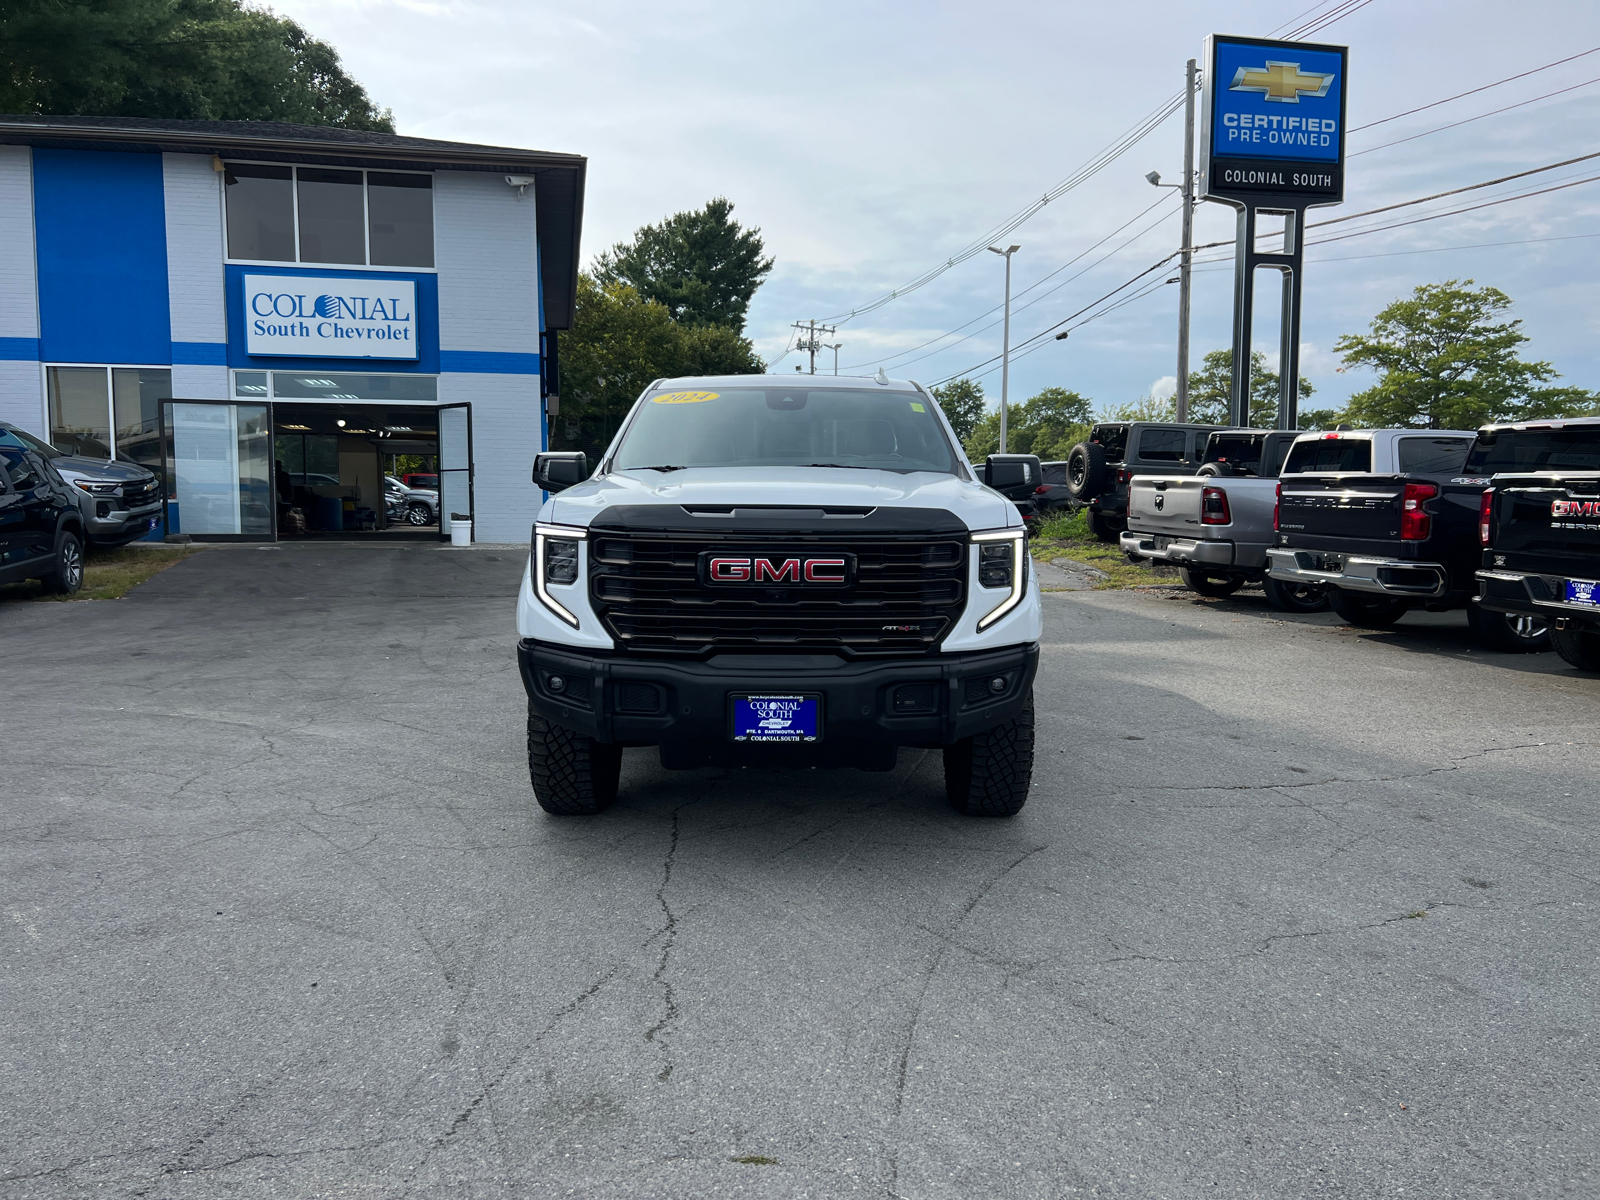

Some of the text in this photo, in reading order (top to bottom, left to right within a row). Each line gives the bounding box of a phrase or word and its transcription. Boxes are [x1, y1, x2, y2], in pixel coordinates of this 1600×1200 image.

[1223, 113, 1336, 132] CERTIFIED
[1229, 129, 1331, 147] PRE-OWNED
[1224, 169, 1331, 187] COLONIAL SOUTH
[251, 292, 410, 322] COLONIAL
[254, 319, 411, 341] South Chevrolet
[660, 392, 713, 403] 2024
[1550, 522, 1600, 530] SIERR
[710, 558, 845, 582] GMC
[750, 701, 800, 710] COLONIAL
[757, 710, 792, 718] SOUTH
